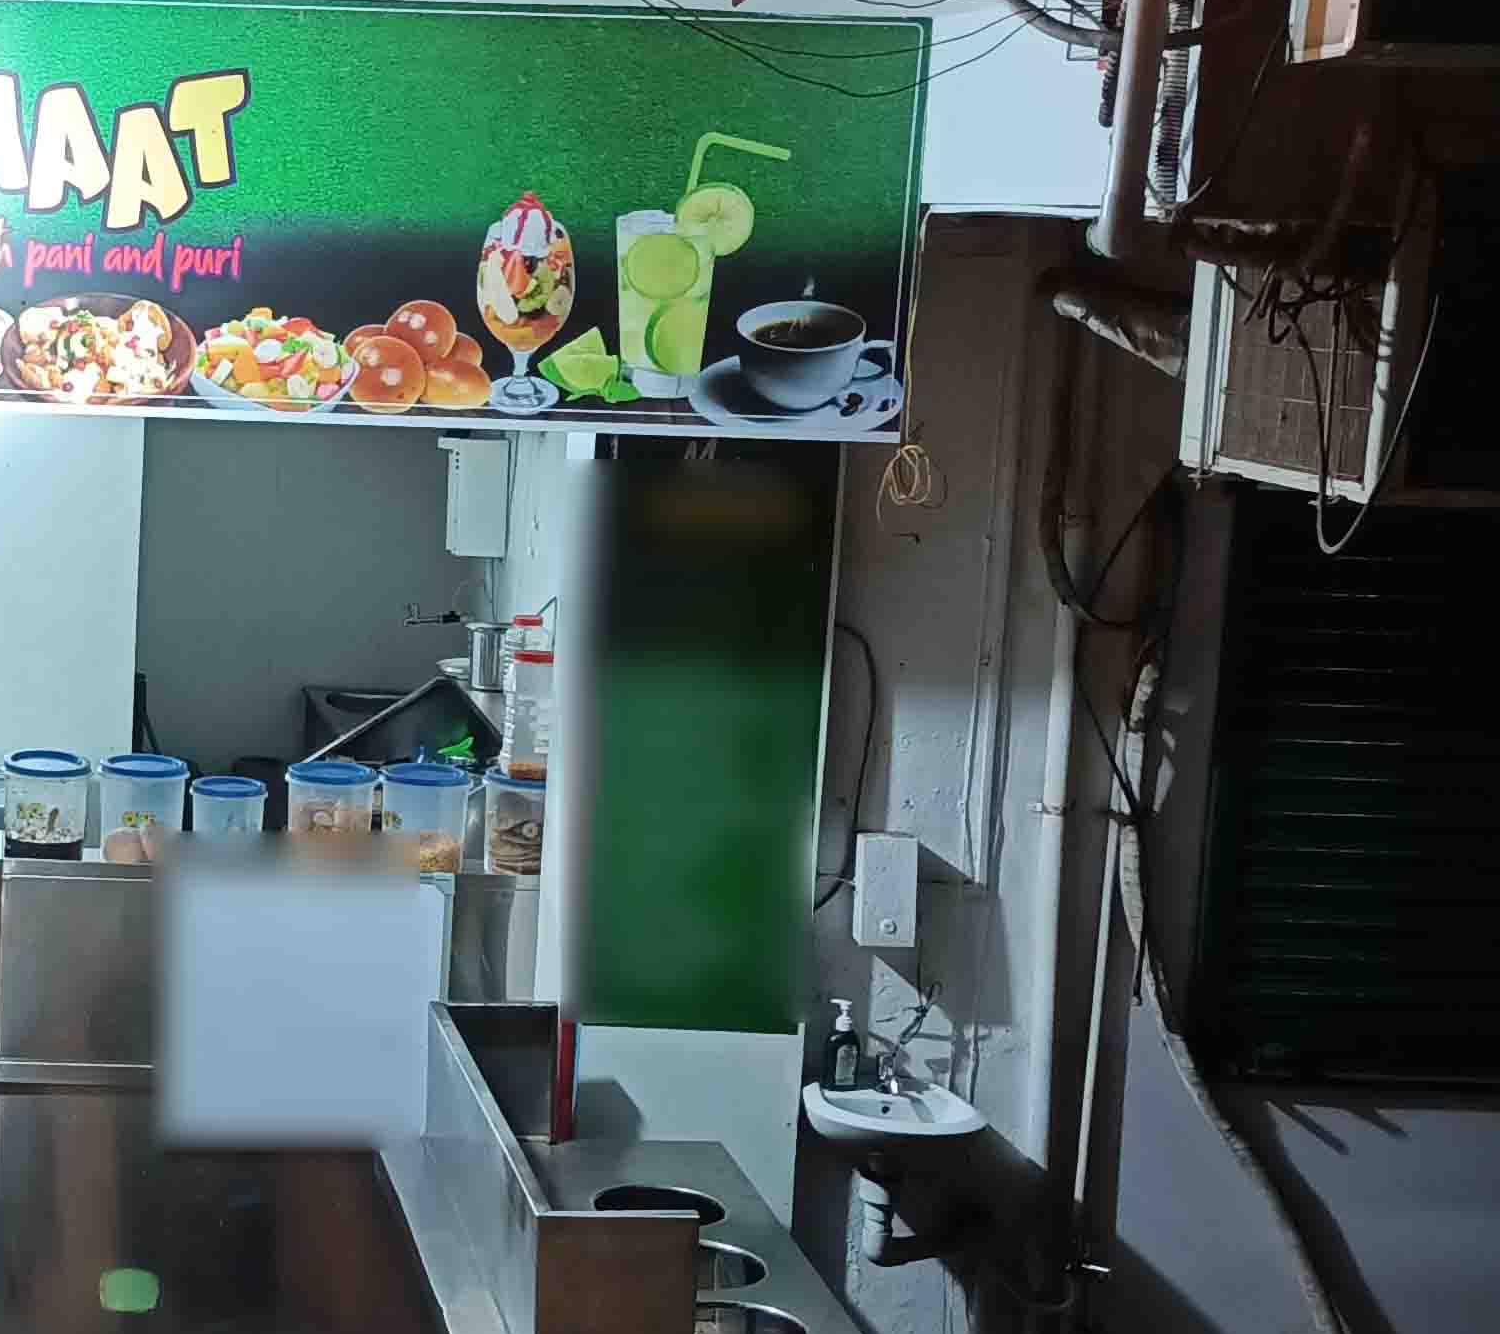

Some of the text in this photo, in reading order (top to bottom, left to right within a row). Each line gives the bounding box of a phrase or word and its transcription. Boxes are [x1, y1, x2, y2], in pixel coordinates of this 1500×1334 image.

[23, 231, 94, 289] pani
[103, 231, 164, 282] and
[171, 234, 244, 293] puri
